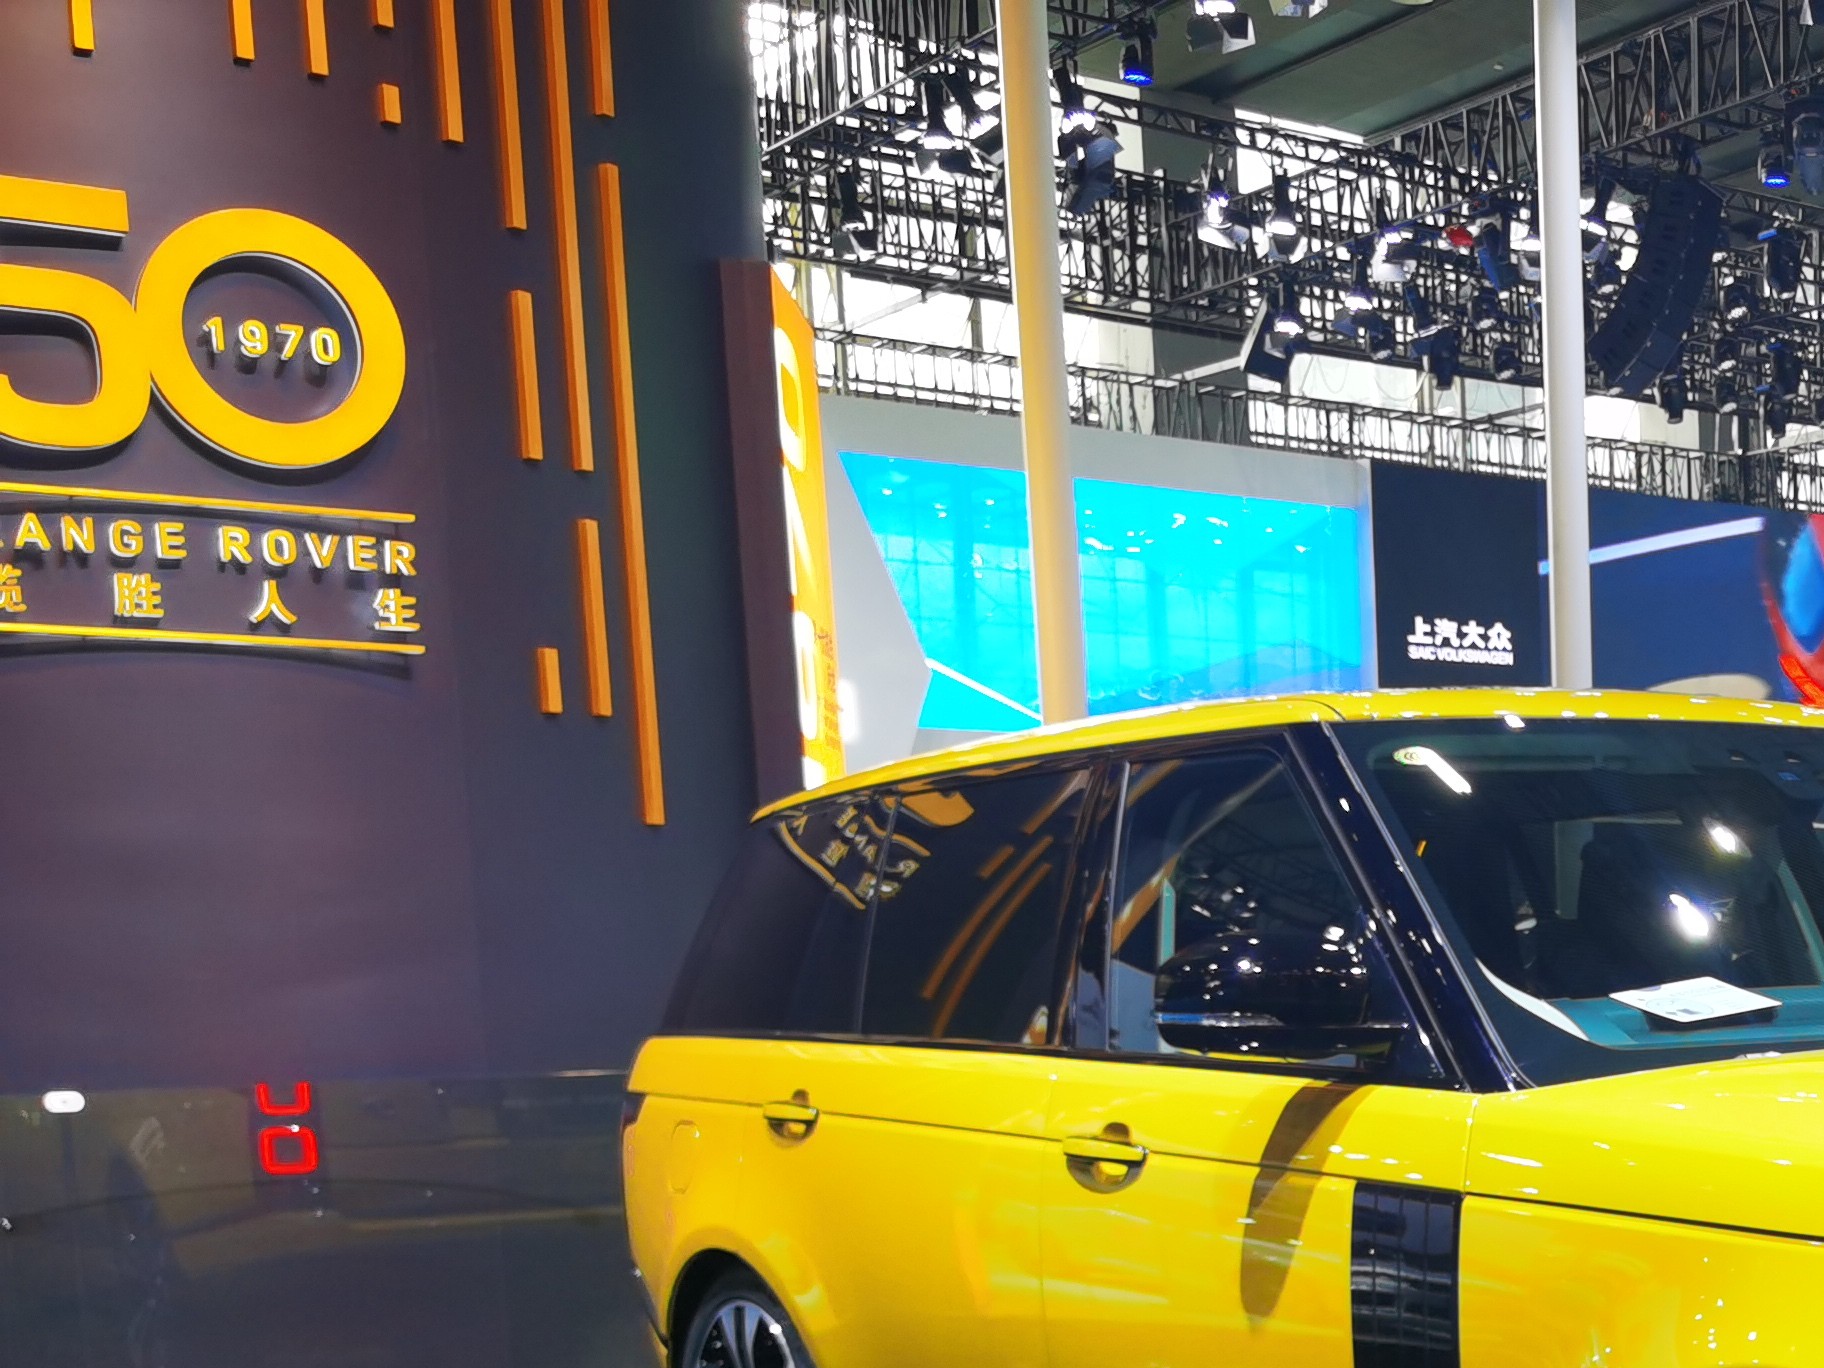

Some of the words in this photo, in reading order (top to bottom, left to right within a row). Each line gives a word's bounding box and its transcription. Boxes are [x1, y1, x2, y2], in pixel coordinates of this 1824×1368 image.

[203, 315, 342, 366] 1970
[0, 512, 188, 560] ANGE
[219, 522, 417, 577] ROVER
[1406, 615, 1513, 651] 上汽大众
[1437, 646, 1514, 666] VOLKSWAGEN
